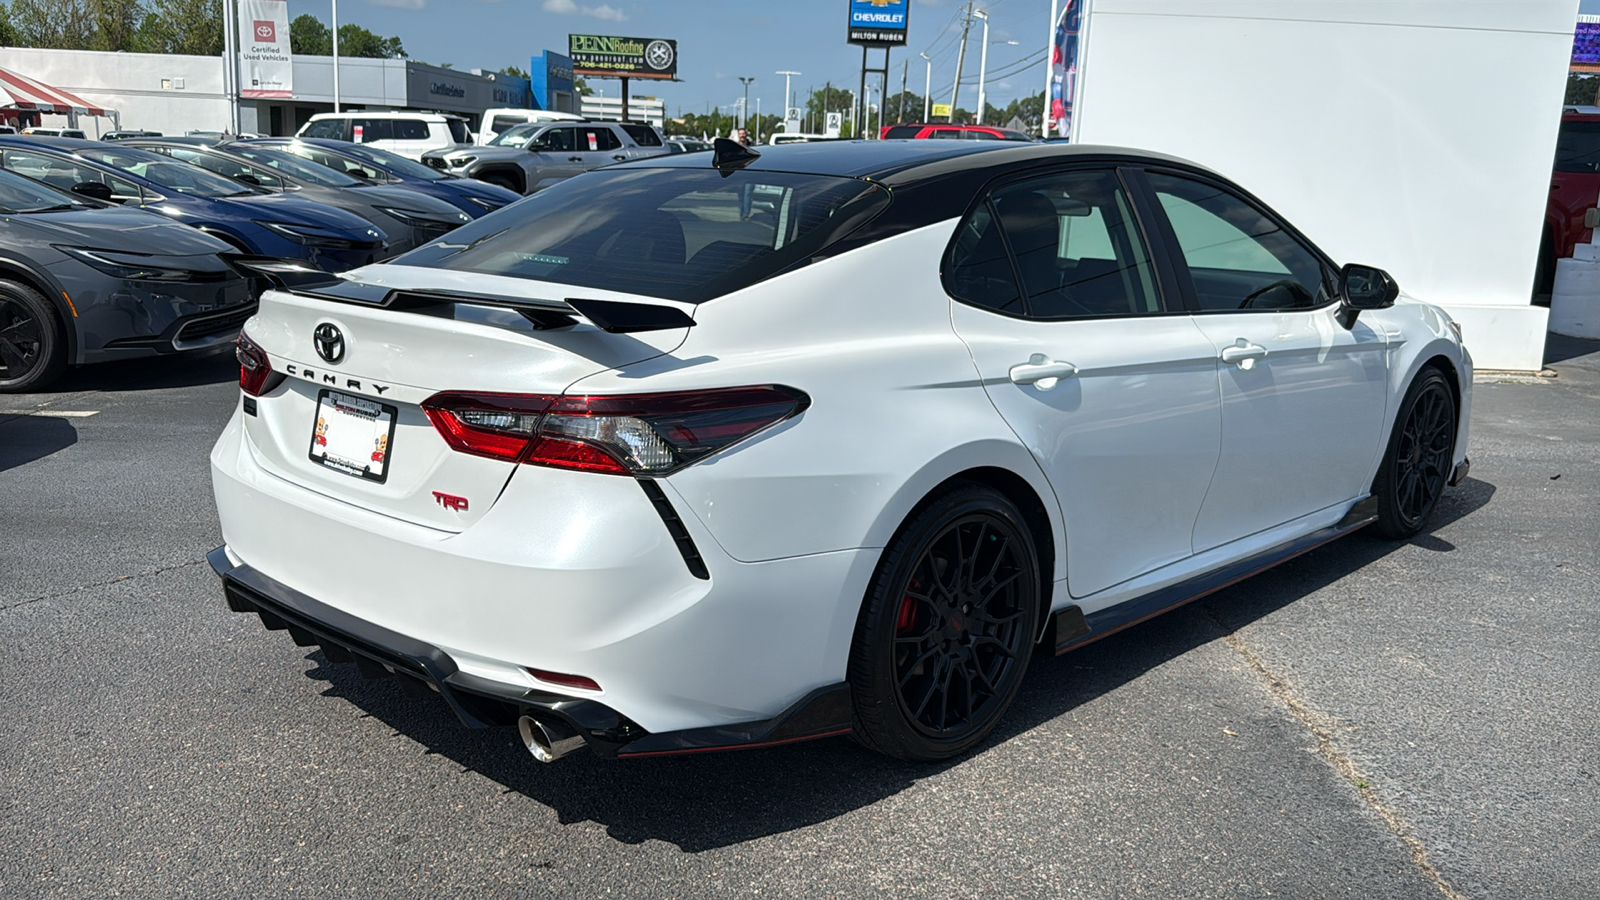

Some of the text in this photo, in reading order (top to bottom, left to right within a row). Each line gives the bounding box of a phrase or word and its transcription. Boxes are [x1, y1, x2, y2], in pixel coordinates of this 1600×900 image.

[853, 13, 903, 23] CHEVROLET
[851, 32, 903, 41] MILTON RUBEN
[570, 35, 621, 52] PENN
[614, 39, 644, 56] Roofing
[571, 54, 644, 64] www.pennroof.com
[286, 364, 390, 395] CAMRY
[432, 491, 469, 512] TRD
